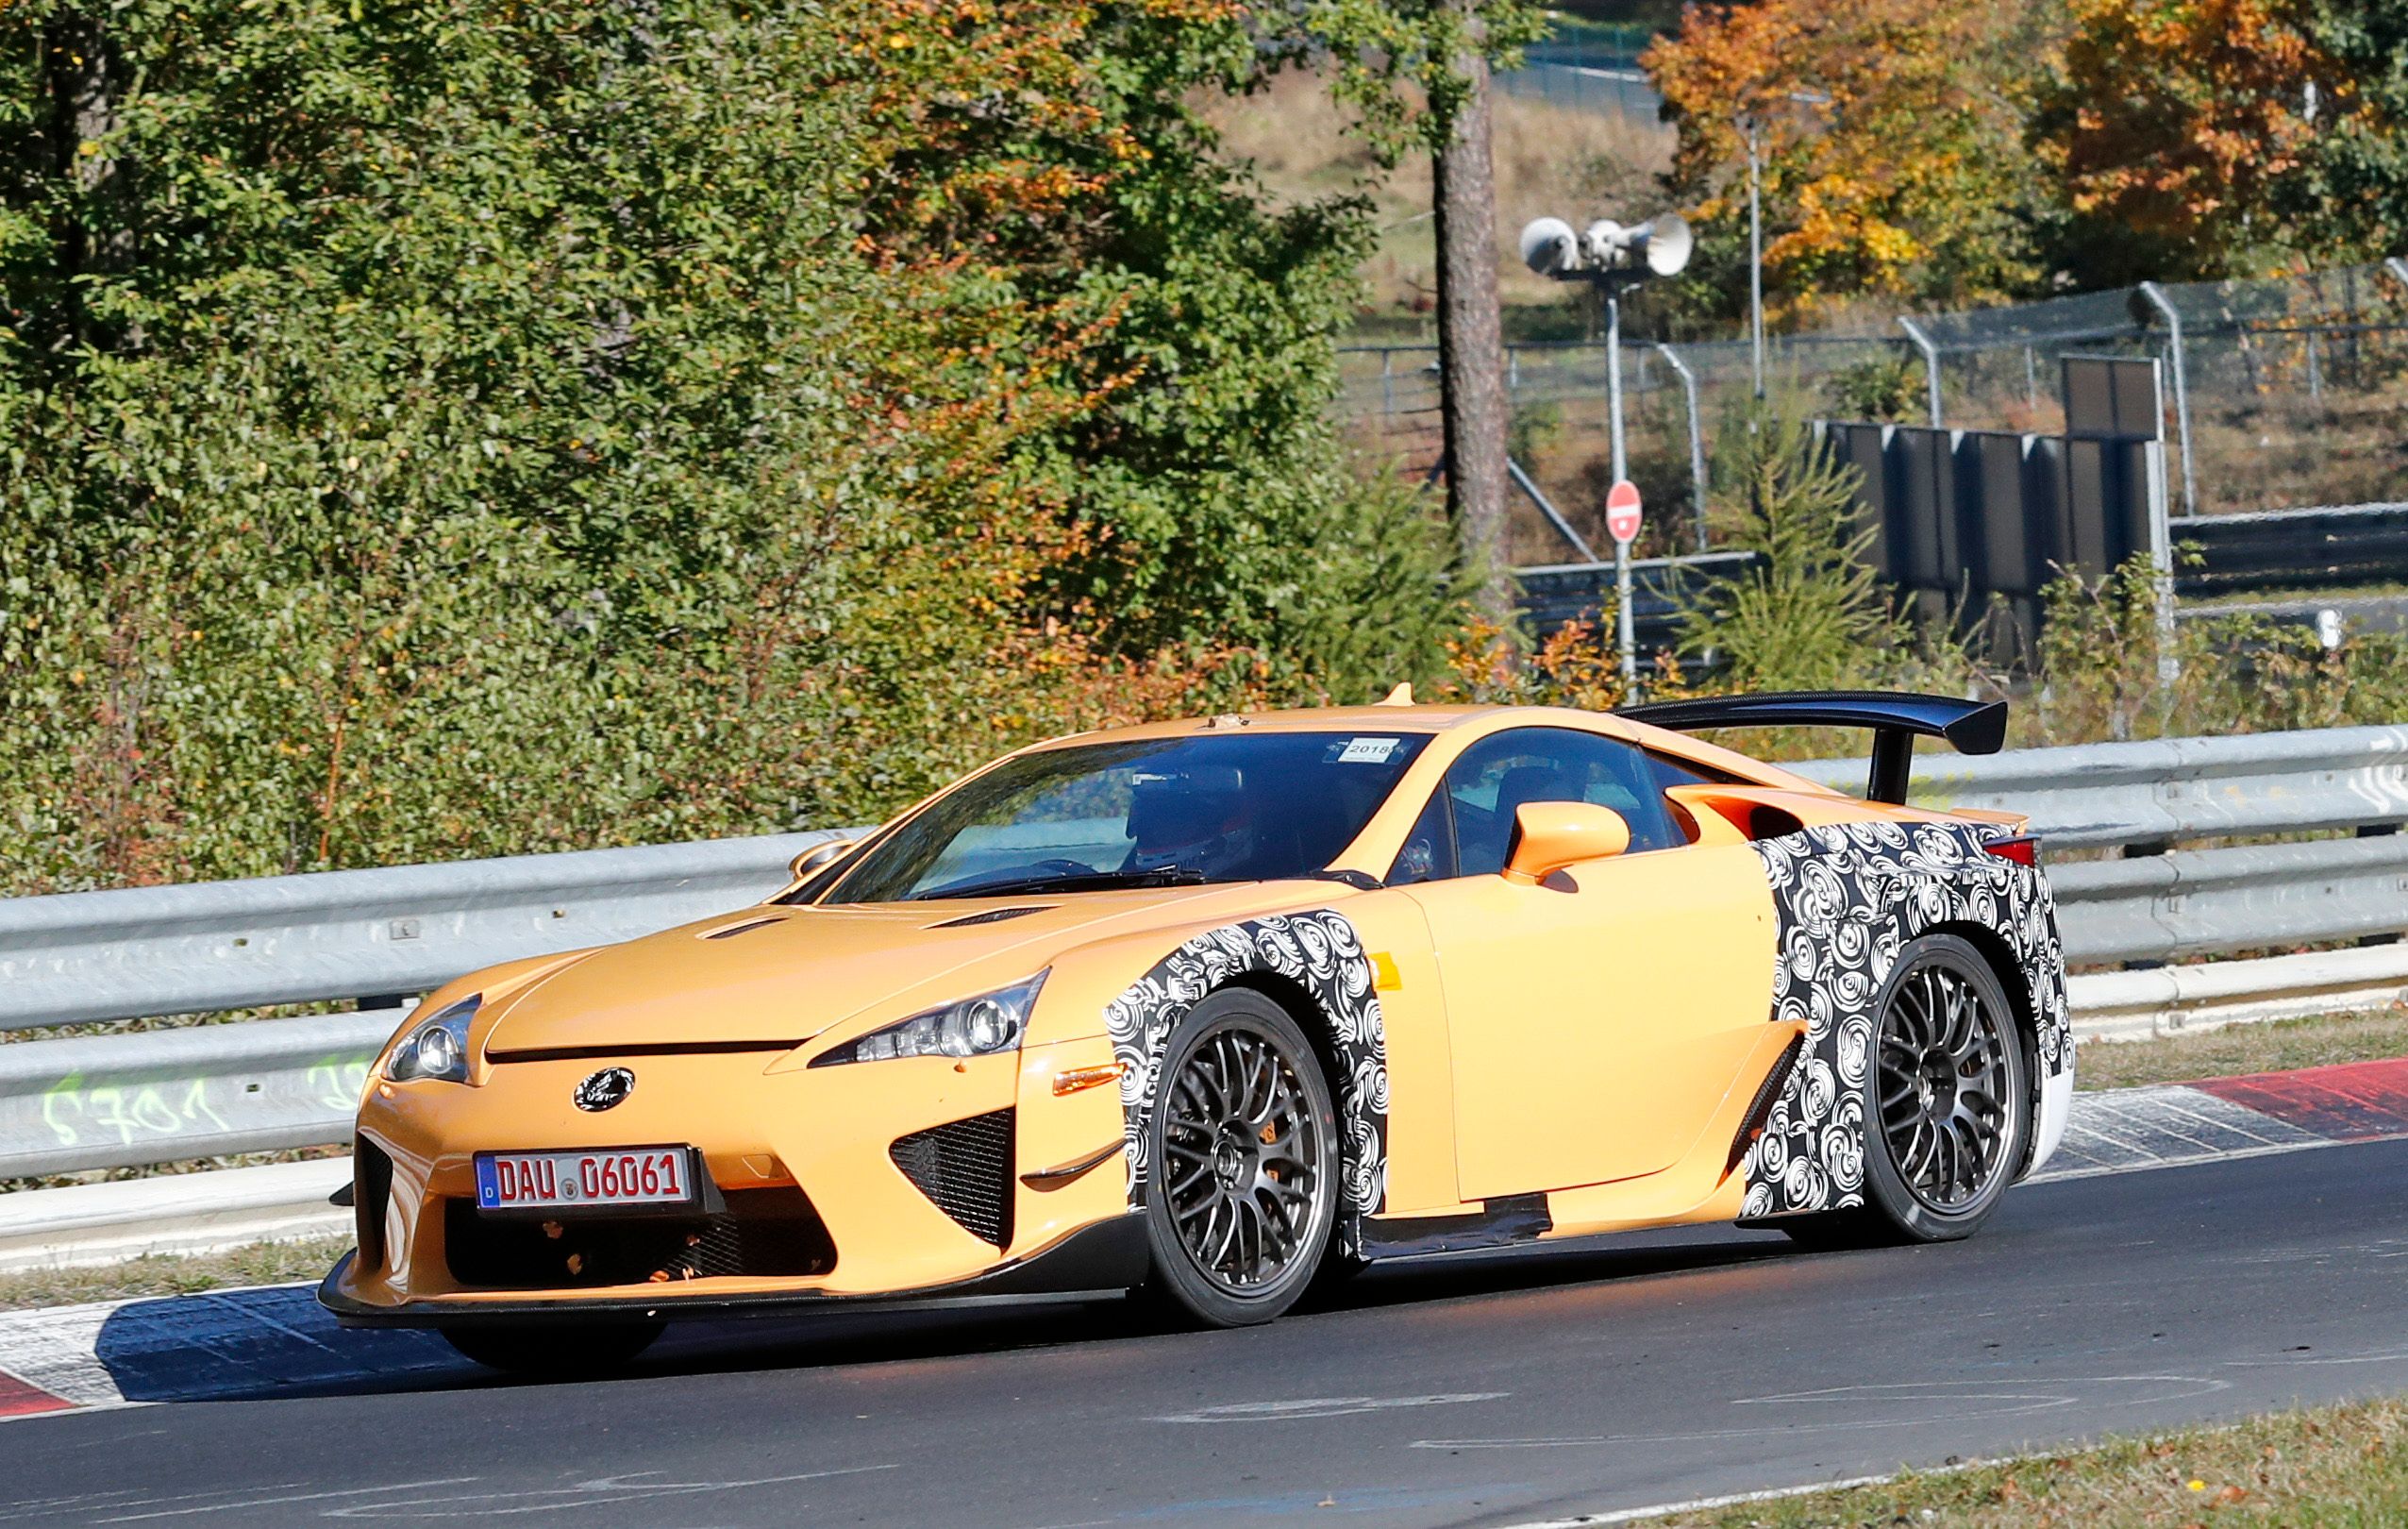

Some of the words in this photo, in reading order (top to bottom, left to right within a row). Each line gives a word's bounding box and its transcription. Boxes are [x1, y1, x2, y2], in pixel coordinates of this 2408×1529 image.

[1349, 745, 1389, 754] 2018
[485, 1186, 493, 1198] D
[495, 1159, 557, 1201] DAU
[579, 1154, 680, 1198] 06061
